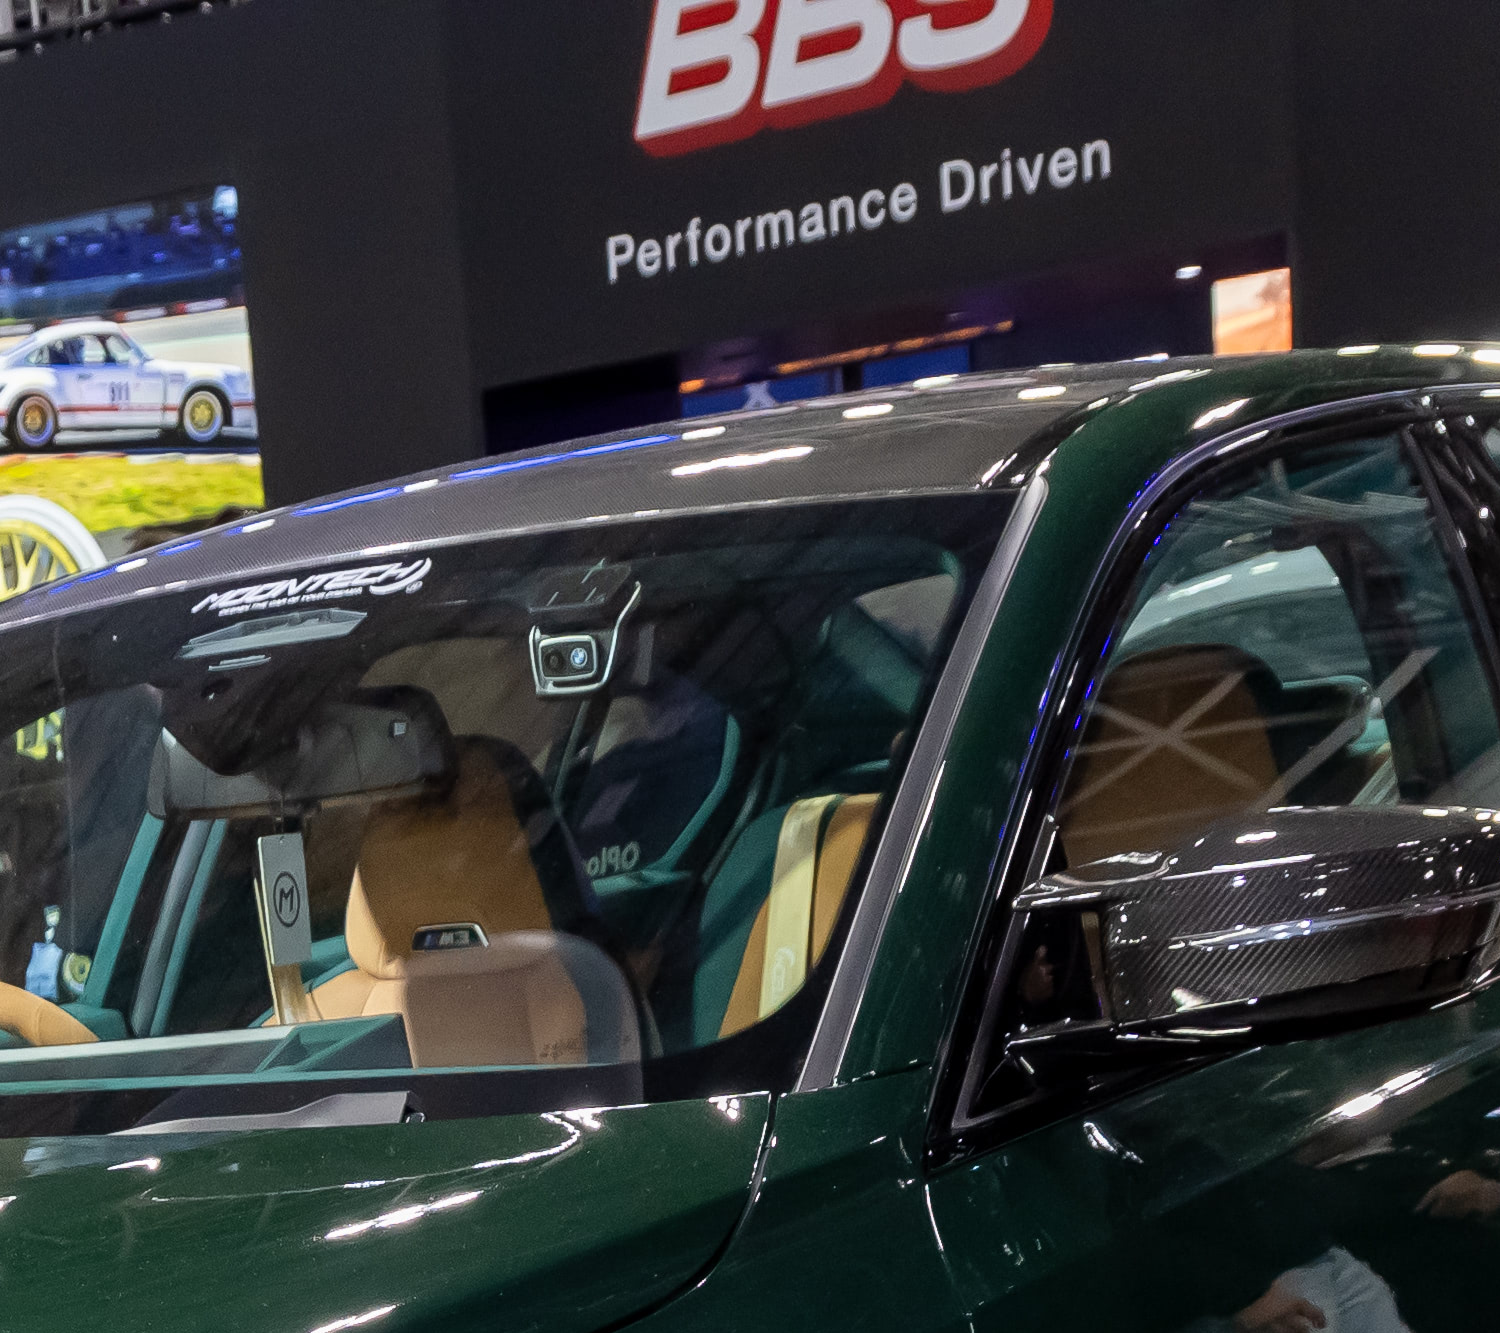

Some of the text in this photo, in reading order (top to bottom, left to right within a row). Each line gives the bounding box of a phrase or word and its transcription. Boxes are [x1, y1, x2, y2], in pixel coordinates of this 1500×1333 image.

[606, 138, 1113, 285] Performance Driven
[190, 558, 432, 614] MOONTECH
